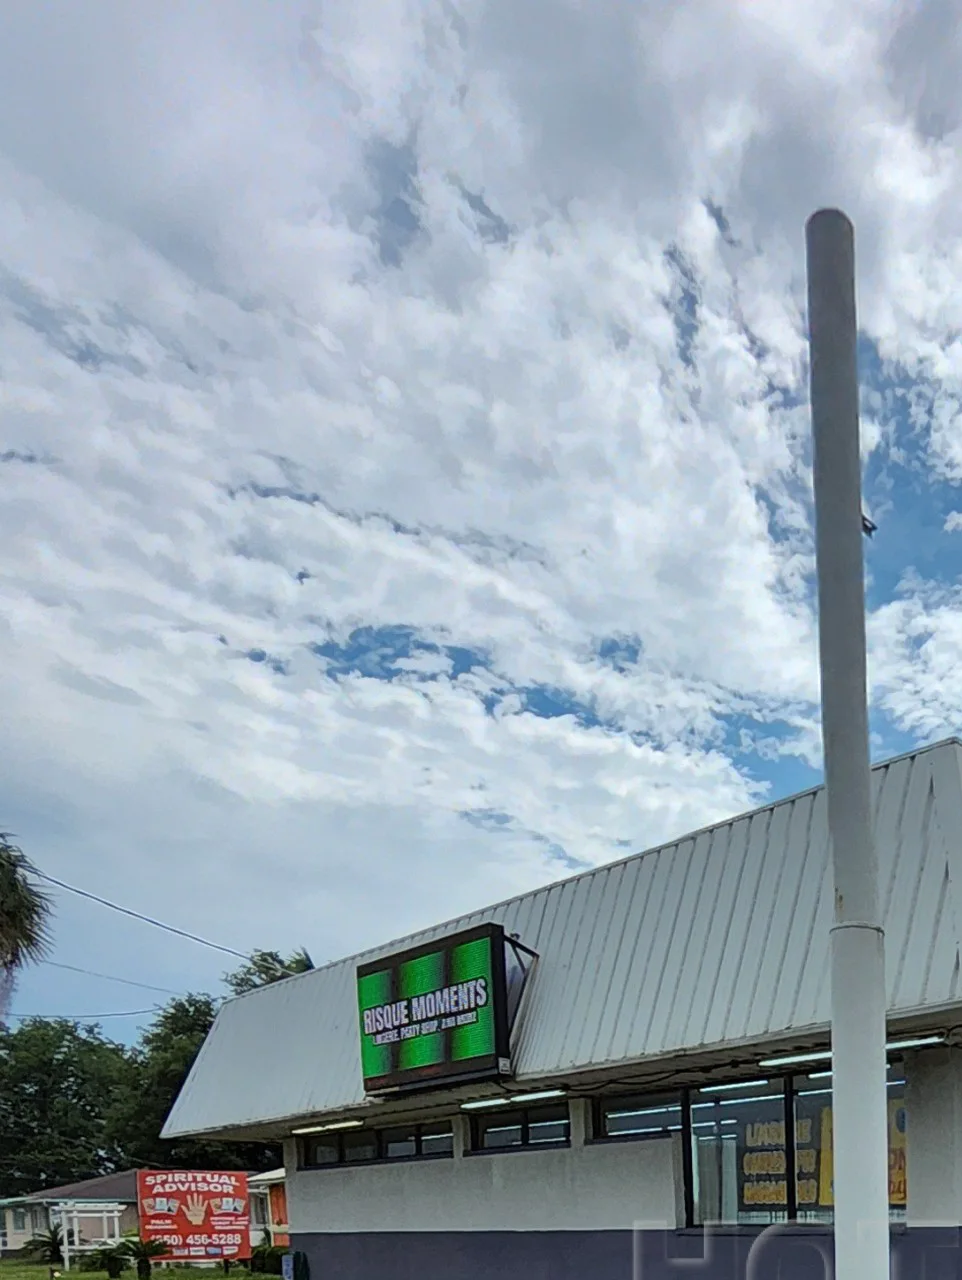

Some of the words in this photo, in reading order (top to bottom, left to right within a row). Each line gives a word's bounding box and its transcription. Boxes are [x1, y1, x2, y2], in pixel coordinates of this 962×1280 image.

[363, 1000, 409, 1034] RISQUE
[411, 978, 487, 1021] MOMENTS
[145, 1173, 240, 1186] SPIRITUAL
[152, 1182, 235, 1194] ADVISOR
[186, 1233, 241, 1246] 456-5288
